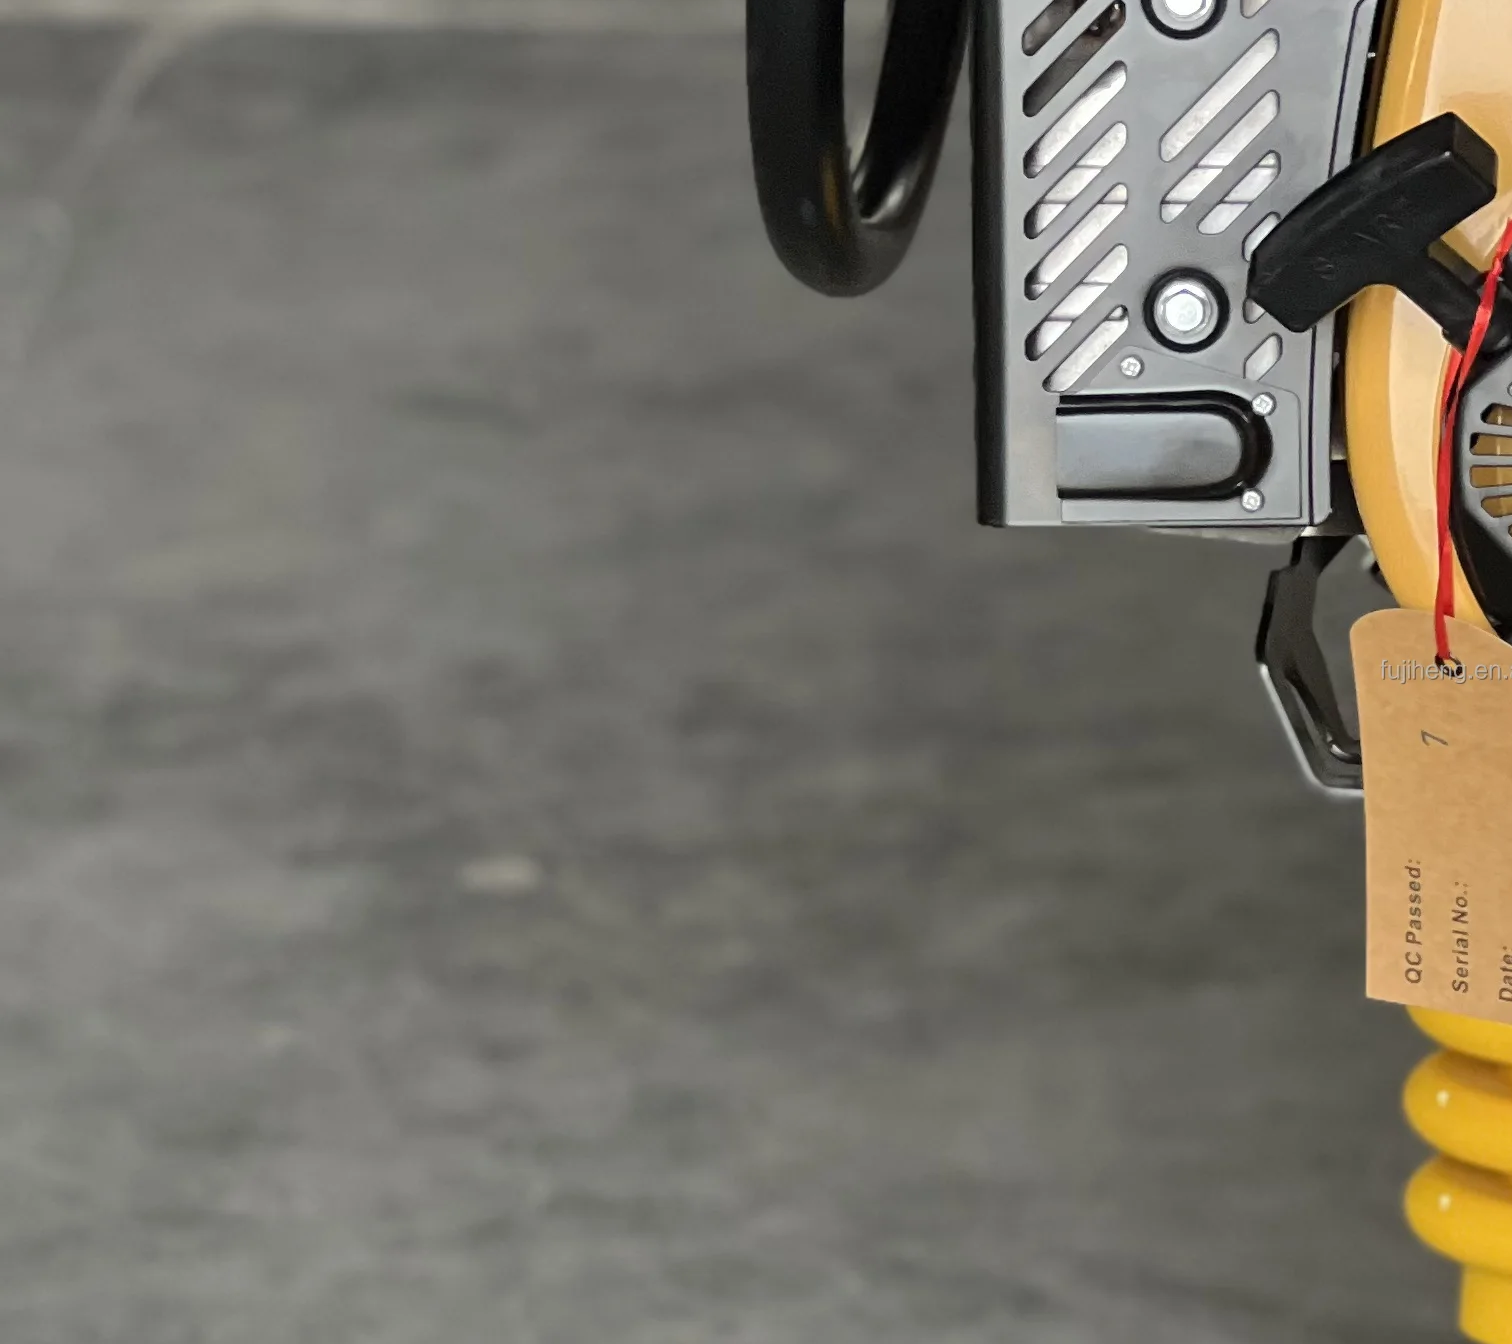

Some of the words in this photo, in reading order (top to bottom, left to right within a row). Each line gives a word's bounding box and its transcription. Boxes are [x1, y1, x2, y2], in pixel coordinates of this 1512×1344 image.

[1405, 859, 1422, 945] Passed:
[1405, 952, 1422, 984] QC
[1452, 930, 1469, 993] Serial
